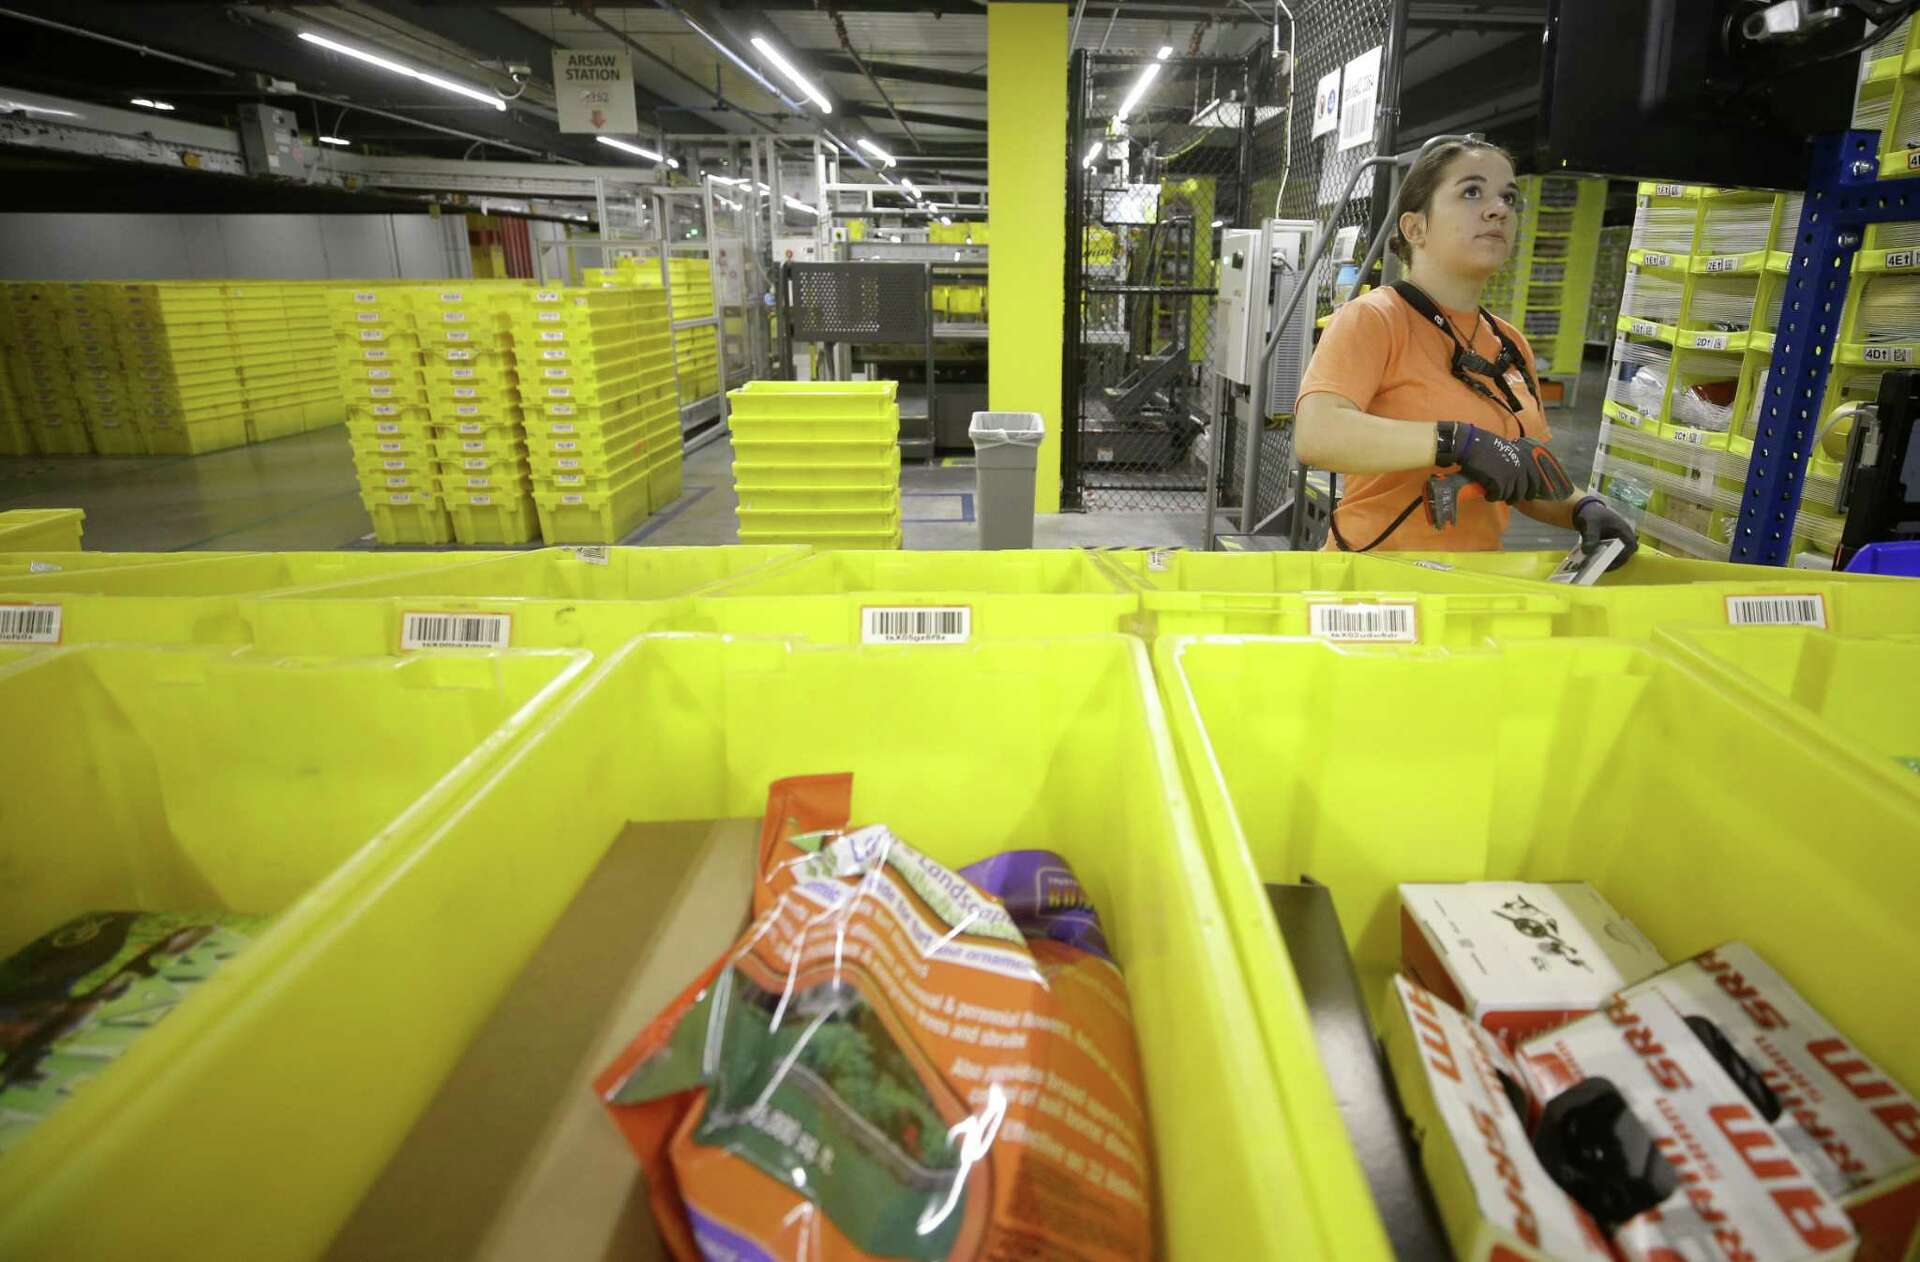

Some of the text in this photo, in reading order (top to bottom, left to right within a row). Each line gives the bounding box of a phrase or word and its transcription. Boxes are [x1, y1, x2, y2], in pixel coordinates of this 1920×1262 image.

[567, 55, 617, 67] ARSAW
[566, 68, 620, 81] STATION
[1888, 256, 1903, 266] 4E
[1865, 349, 1881, 360] 4D
[1493, 437, 1521, 467] HyFlex
